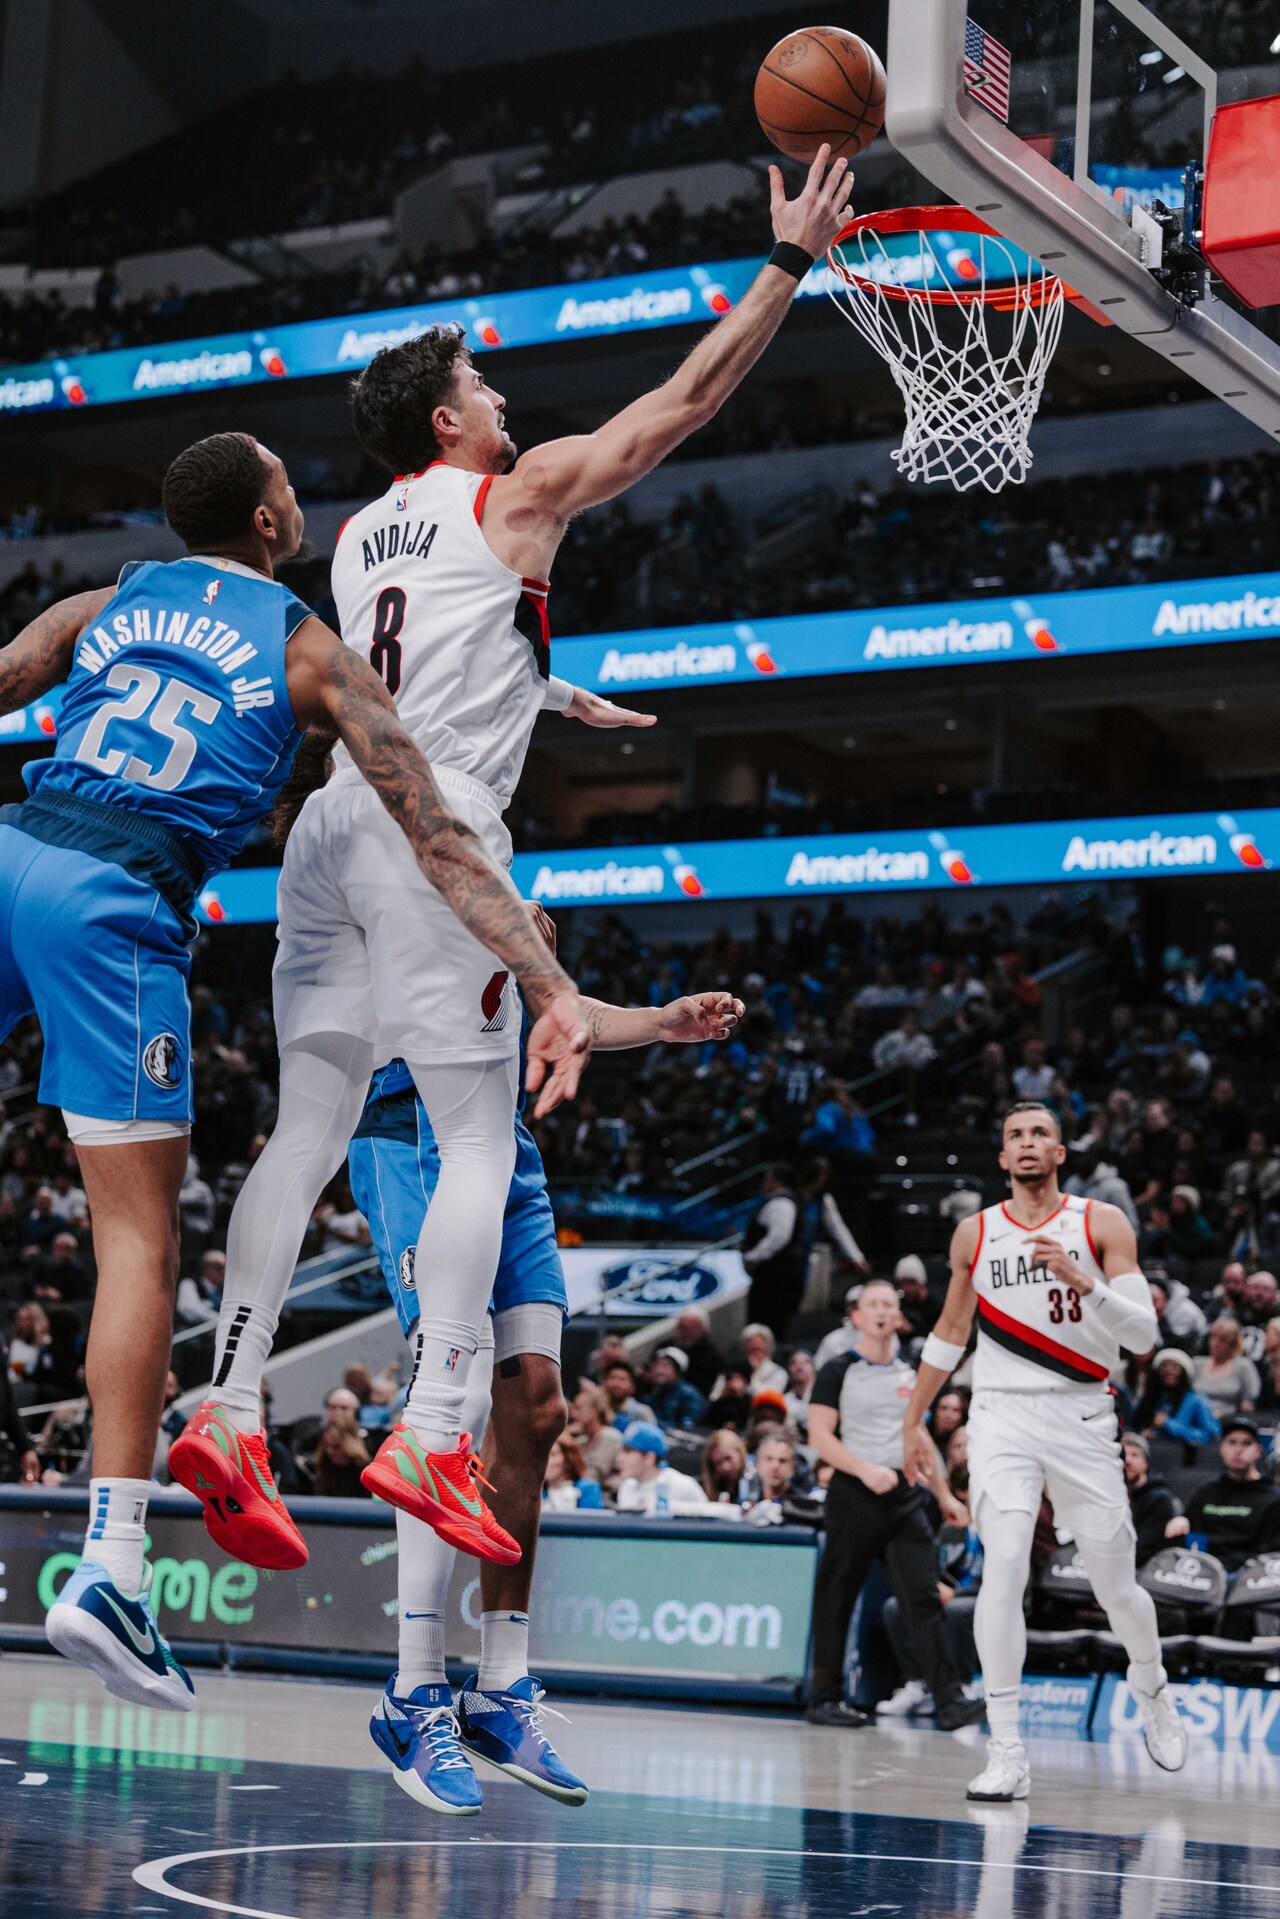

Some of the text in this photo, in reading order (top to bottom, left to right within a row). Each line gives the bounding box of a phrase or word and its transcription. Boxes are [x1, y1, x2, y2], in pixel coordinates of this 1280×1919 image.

[793, 252, 936, 299] merican
[556, 288, 692, 332] American
[133, 351, 252, 390] American
[362, 521, 438, 572] AVDIJA
[370, 586, 407, 697] 8
[863, 619, 1013, 660] American
[76, 609, 275, 718] WASHINGTON JR.
[598, 643, 736, 682] American
[74, 663, 222, 791] 25
[786, 847, 930, 887] American
[1062, 831, 1217, 872] American
[531, 862, 664, 899] American
[1048, 1287, 1083, 1325] 33
[1108, 1680, 1280, 1740] USW
